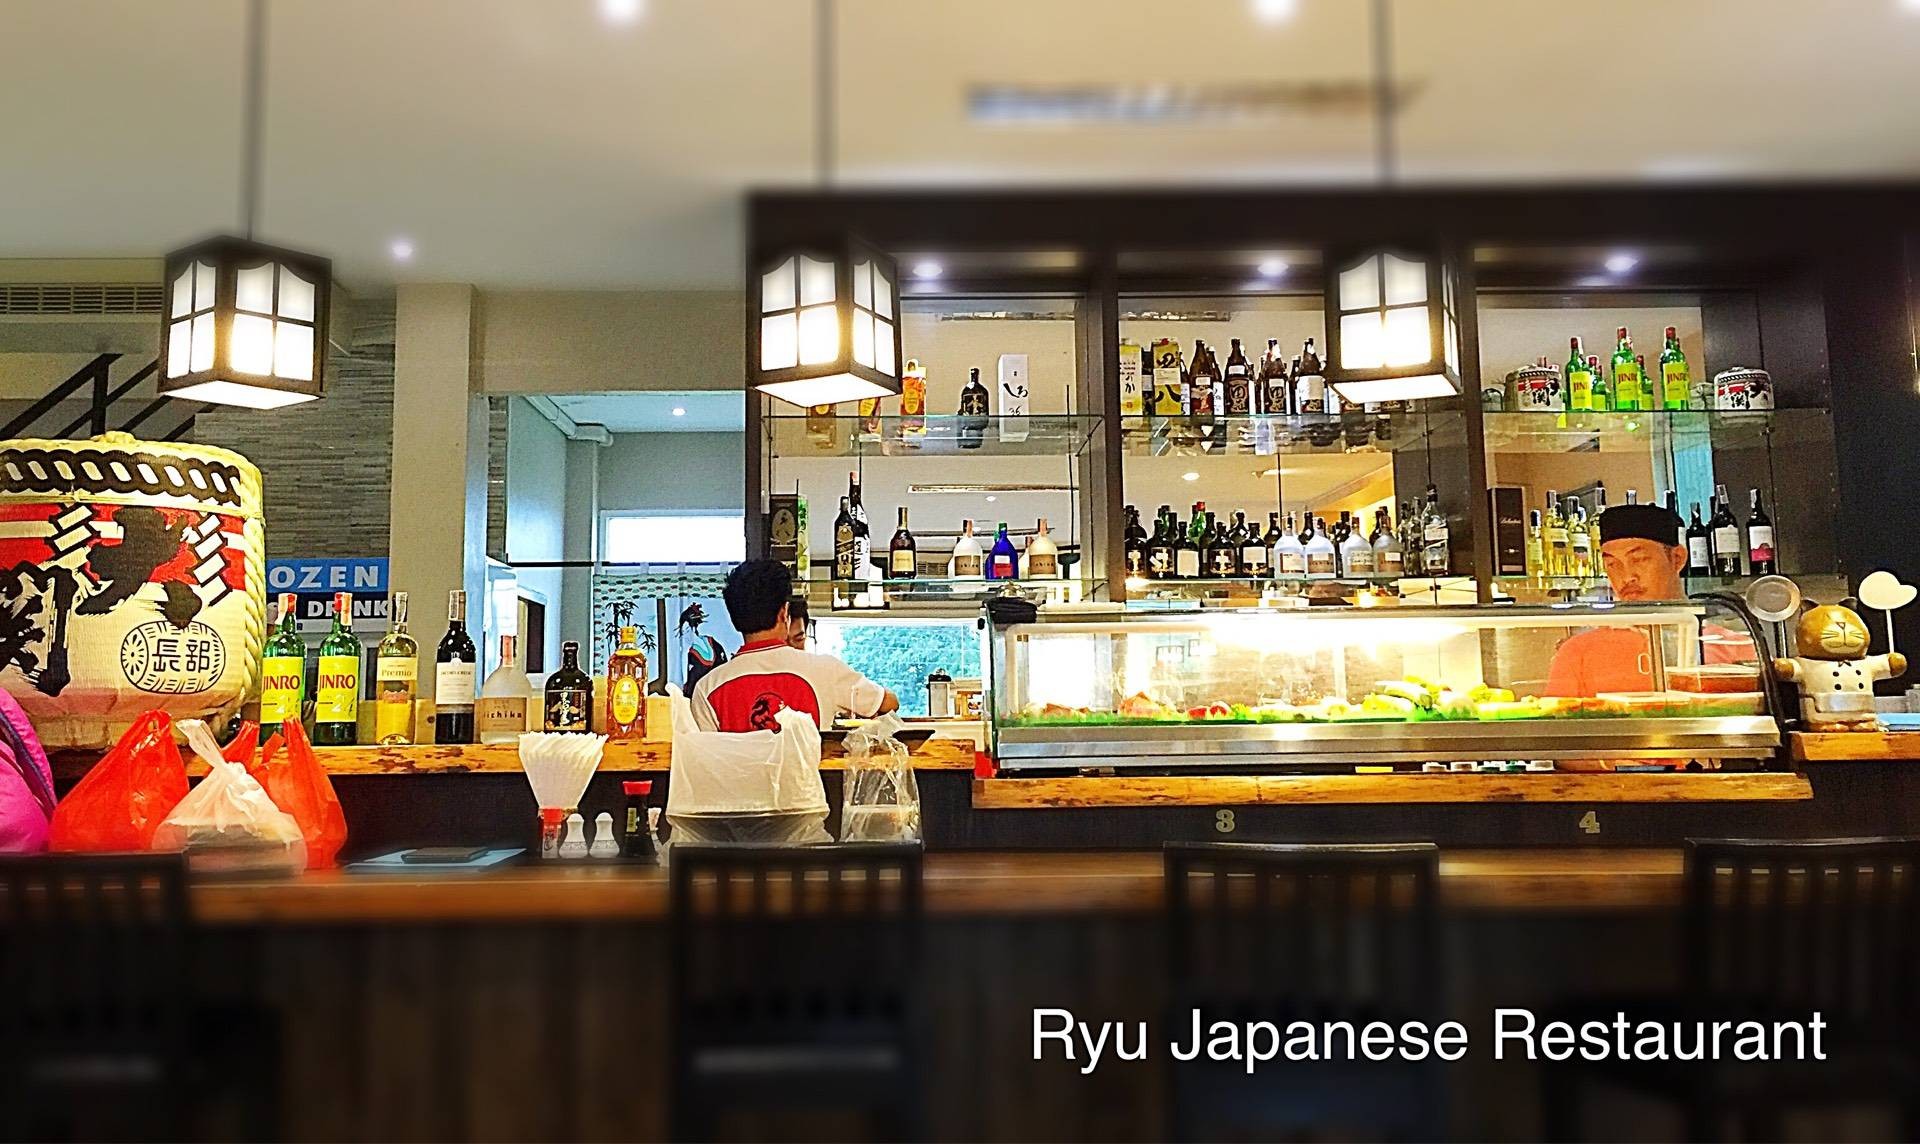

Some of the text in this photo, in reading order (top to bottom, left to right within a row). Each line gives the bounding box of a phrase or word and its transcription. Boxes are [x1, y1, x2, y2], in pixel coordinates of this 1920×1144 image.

[268, 565, 379, 589] OZEN
[262, 675, 301, 692] JINRO
[318, 674, 356, 692] JINRO
[1215, 810, 1236, 833] 3
[1578, 811, 1600, 834] 4
